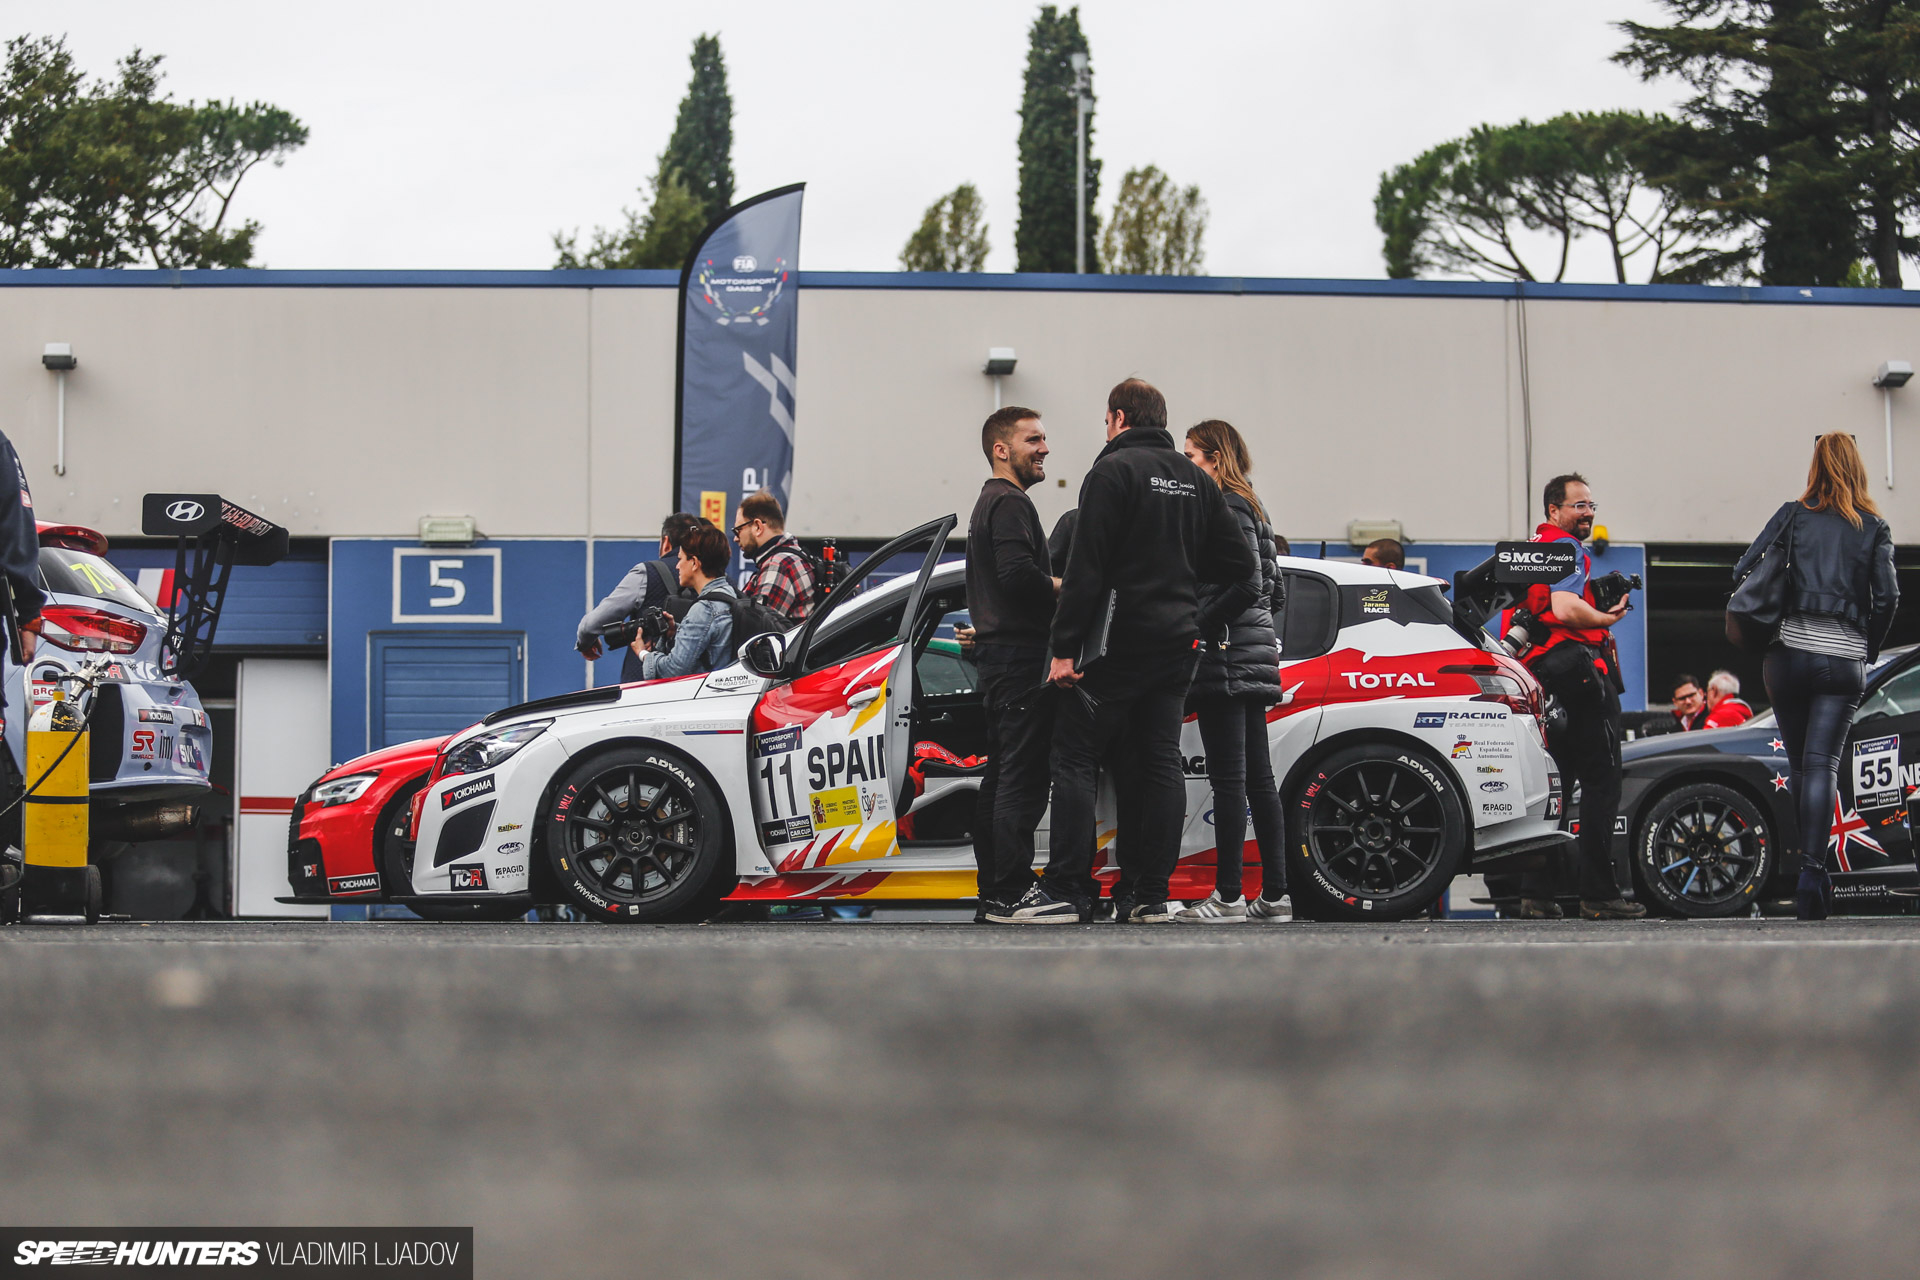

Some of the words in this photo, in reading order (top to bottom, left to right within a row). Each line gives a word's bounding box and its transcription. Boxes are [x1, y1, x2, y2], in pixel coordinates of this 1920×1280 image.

[733, 259, 755, 270] FIA
[1150, 476, 1178, 489] SMC
[1498, 551, 1544, 564] SMC
[1545, 553, 1574, 565] junior
[1509, 564, 1563, 572] MOTORSPORT
[69, 562, 117, 595] 70
[429, 559, 467, 608] 5
[725, 675, 749, 683] ACTION
[1340, 671, 1436, 690] TOTAL
[148, 711, 173, 721] YOKOHAMA
[1416, 716, 1445, 724] RTS
[1448, 712, 1508, 720] RACING
[665, 723, 720, 731] PEUGEOT
[132, 730, 155, 752] SR
[761, 732, 794, 744] MOTORSPORT
[768, 742, 787, 751] GAMES
[179, 744, 196, 764] SVK
[645, 756, 696, 790] ADVAN
[1397, 755, 1445, 793] ADVAN
[1860, 756, 1893, 790] 55
[453, 779, 492, 801] YOKOHAMA
[761, 753, 798, 820] 11
[788, 818, 810, 828] TOURING
[801, 828, 811, 836] CUP
[1646, 821, 1658, 866] ADVAN
[502, 864, 524, 874] PAGID
[339, 878, 377, 889] YOKOHAMA
[452, 868, 482, 888] TCR
[1313, 869, 1345, 900] YOKOHAMA
[573, 879, 608, 909] YOKOHAMA
[1834, 885, 1857, 893] Audi
[1858, 884, 1887, 893] Sport
